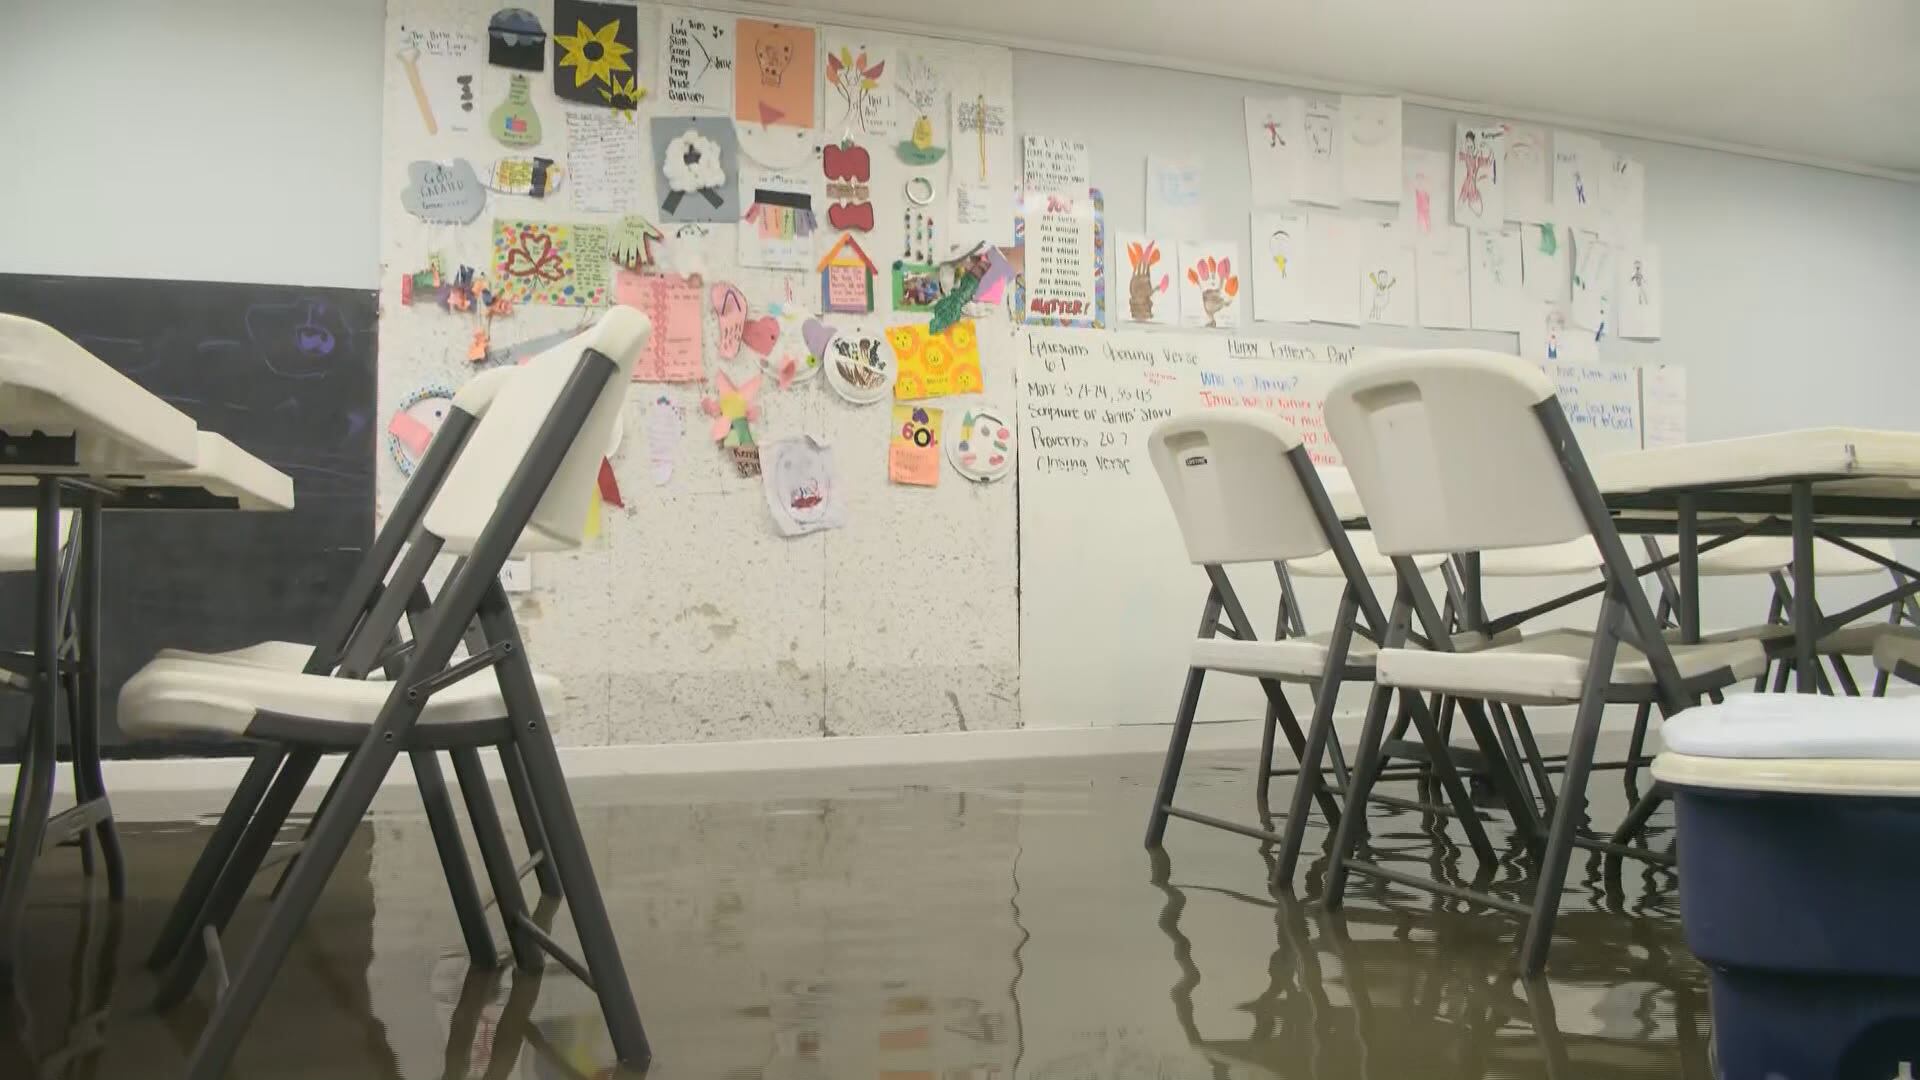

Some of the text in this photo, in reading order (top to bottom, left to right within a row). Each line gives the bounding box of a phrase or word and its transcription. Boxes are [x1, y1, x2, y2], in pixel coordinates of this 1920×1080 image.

[1028, 333, 1089, 358] Ephesians
[1028, 382, 1056, 398] Mark
[1028, 403, 1080, 422] Scripture
[1030, 425, 1088, 449] Proverbs
[1037, 455, 1087, 475] Closing
